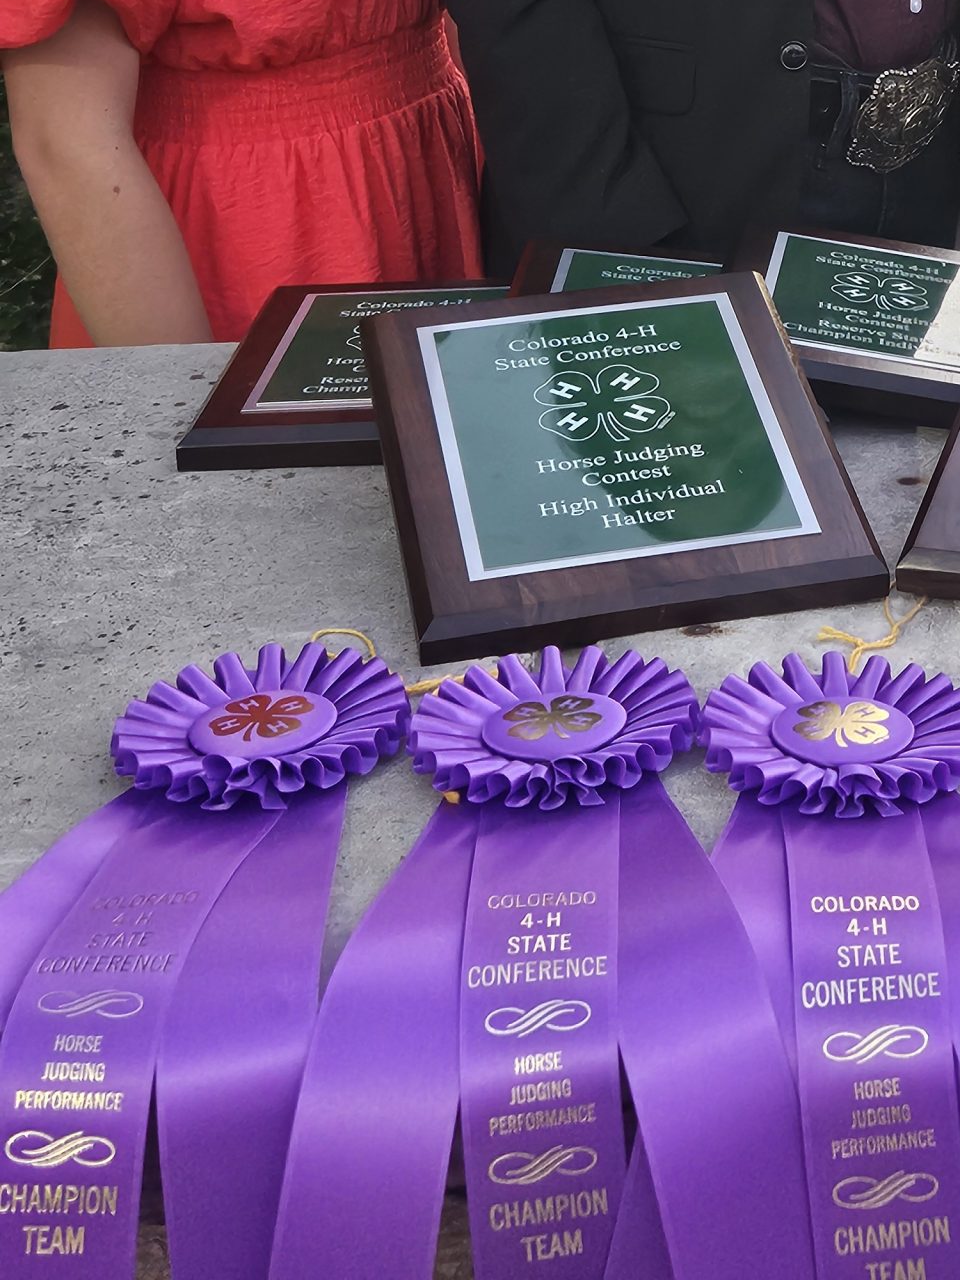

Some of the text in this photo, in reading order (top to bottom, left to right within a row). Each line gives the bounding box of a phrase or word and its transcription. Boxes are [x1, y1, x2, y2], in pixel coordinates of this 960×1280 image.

[616, 265, 692, 279] Colorado
[815, 255, 953, 284] State Conference
[830, 251, 939, 275] Colorado 4-H
[601, 270, 642, 281] State
[846, 275, 915, 292] H H
[357, 301, 434, 310] Colorado
[818, 301, 868, 316] Horse
[843, 288, 916, 307] H H
[783, 321, 873, 344] Champion
[819, 319, 887, 337] Reserve
[845, 315, 910, 331] Contest
[509, 324, 657, 352] Colorado 4-H
[327, 357, 365, 366] Hor
[495, 340, 682, 371] State Conference
[302, 385, 369, 394] Champ
[320, 376, 369, 384] Reser
[549, 372, 641, 399] H H
[556, 412, 589, 432] H
[623, 403, 656, 422] H
[536, 443, 705, 474] Horse Judging
[582, 465, 672, 487] Contest
[538, 480, 726, 517] High Individual
[601, 508, 676, 529] Halter
[487, 891, 597, 909] COLORADO
[811, 895, 919, 913] COLORADO
[112, 912, 154, 926] 4H
[520, 912, 561, 929] 4-H
[846, 917, 888, 937] 4-H
[86, 931, 153, 949] STATE
[507, 933, 572, 955] STATE
[37, 952, 176, 974] CONFERENCE
[837, 944, 902, 968] STATE
[468, 956, 608, 989] CONFERENCE
[802, 972, 941, 1009] CONFERENCE
[54, 1034, 103, 1053] HORSE
[41, 1061, 105, 1082] JUDGING
[514, 1051, 563, 1075] HORSE
[509, 1078, 572, 1106] JUDGING
[854, 1077, 901, 1100] HORSE
[14, 1090, 124, 1111] PERFORMANCE
[489, 1103, 597, 1137] PERFORMANCE
[851, 1104, 911, 1130] JUDGING
[831, 1129, 937, 1160] PERFORMANCE
[0, 1184, 118, 1216] CHAMPION
[489, 1187, 608, 1231] CHAMPION
[22, 1225, 85, 1255] TEAM
[520, 1228, 583, 1263] TEAM
[834, 1216, 951, 1256] CHAMPION
[865, 1257, 927, 1280] TEAM
